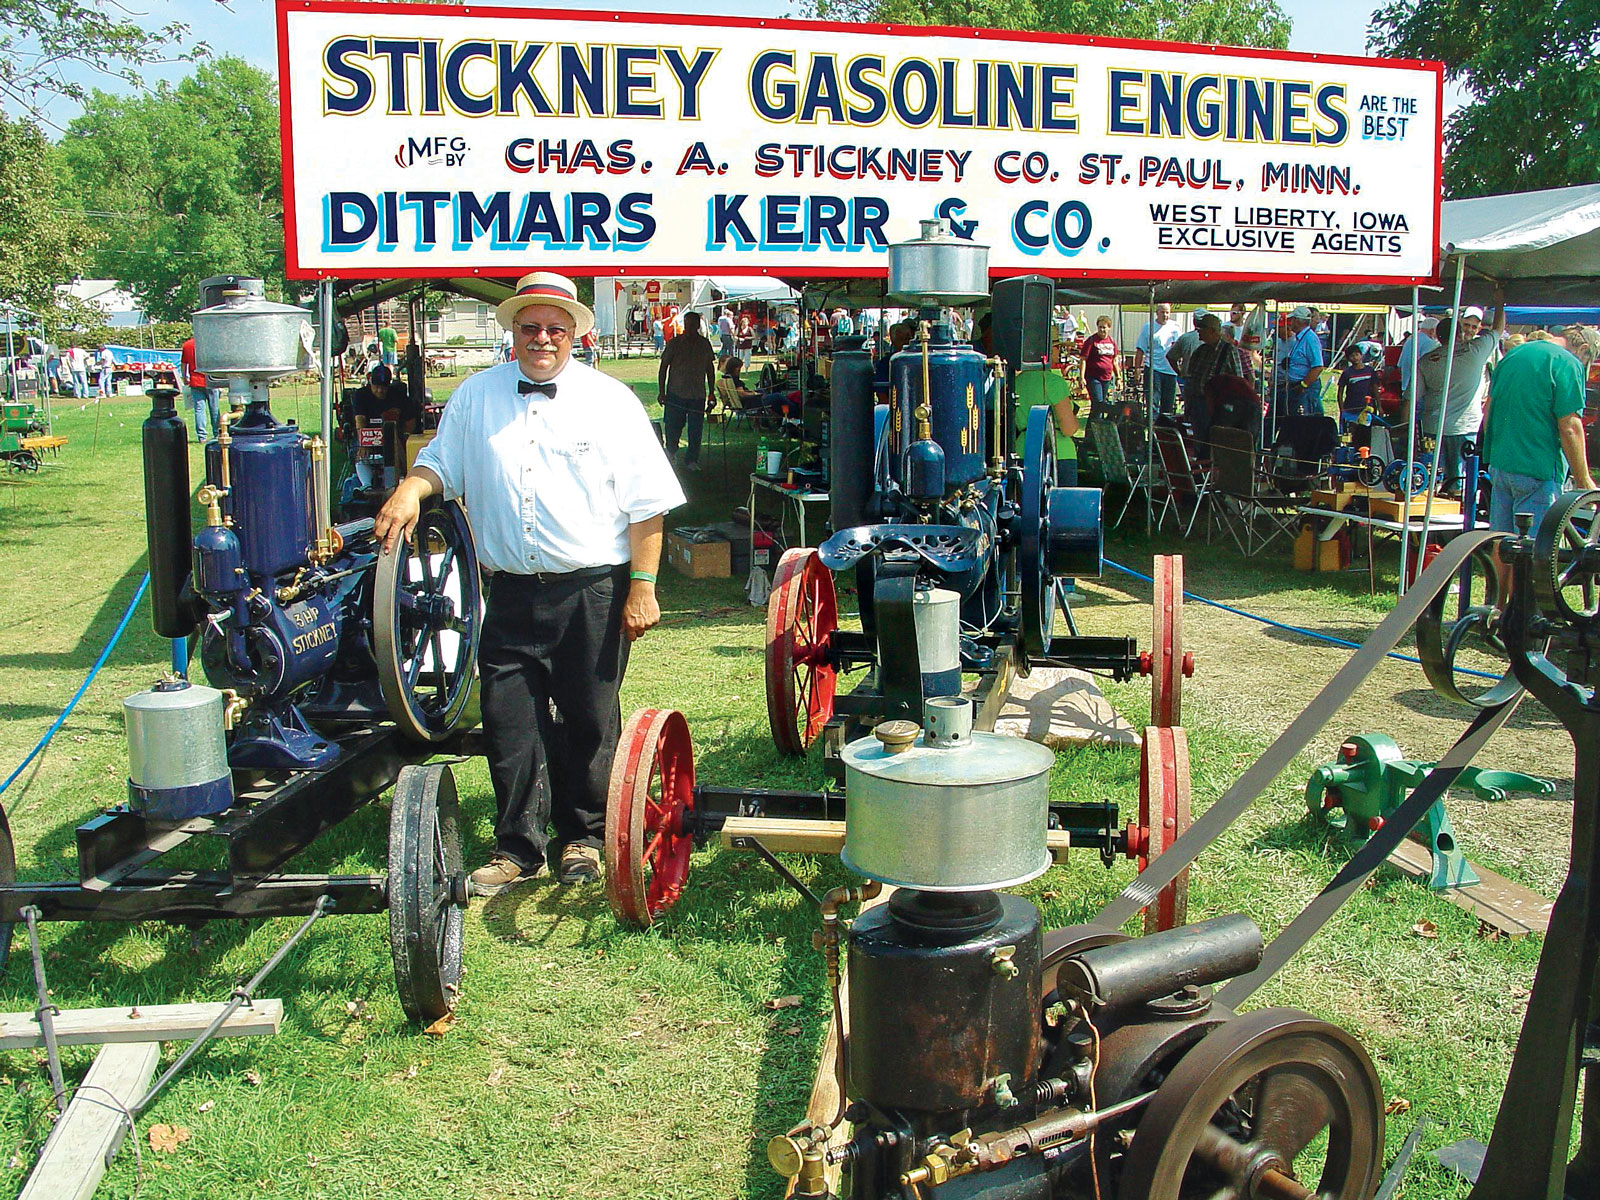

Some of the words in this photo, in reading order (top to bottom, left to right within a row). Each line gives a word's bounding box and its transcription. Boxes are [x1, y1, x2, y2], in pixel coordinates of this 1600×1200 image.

[322, 34, 722, 121] STICKNEY
[748, 49, 1080, 134] GASOLINE
[1106, 66, 1350, 148] ENGINES
[1360, 94, 1388, 112] ARE
[1392, 96, 1418, 115] THE
[1362, 114, 1409, 140] BEST
[407, 136, 471, 167] MFG.
[445, 153, 467, 167] BY
[505, 137, 653, 175] CHAS.
[676, 141, 729, 176] A.
[755, 142, 973, 183] STICKNEY
[994, 150, 1061, 184] CO.
[1078, 152, 1131, 185] ST.
[1138, 155, 1245, 192] PAUL,
[1261, 160, 1361, 196] MINN.
[321, 190, 656, 253] DITMARS
[705, 193, 891, 253] KERR
[934, 197, 979, 241] &
[1011, 199, 1111, 257] CO.
[1149, 203, 1222, 224] WEST
[1353, 211, 1410, 232] IOWA
[1158, 227, 1295, 249] EXCLUSIVE
[1311, 232, 1402, 253] AGENTS
[292, 621, 338, 655] STICKNEY
